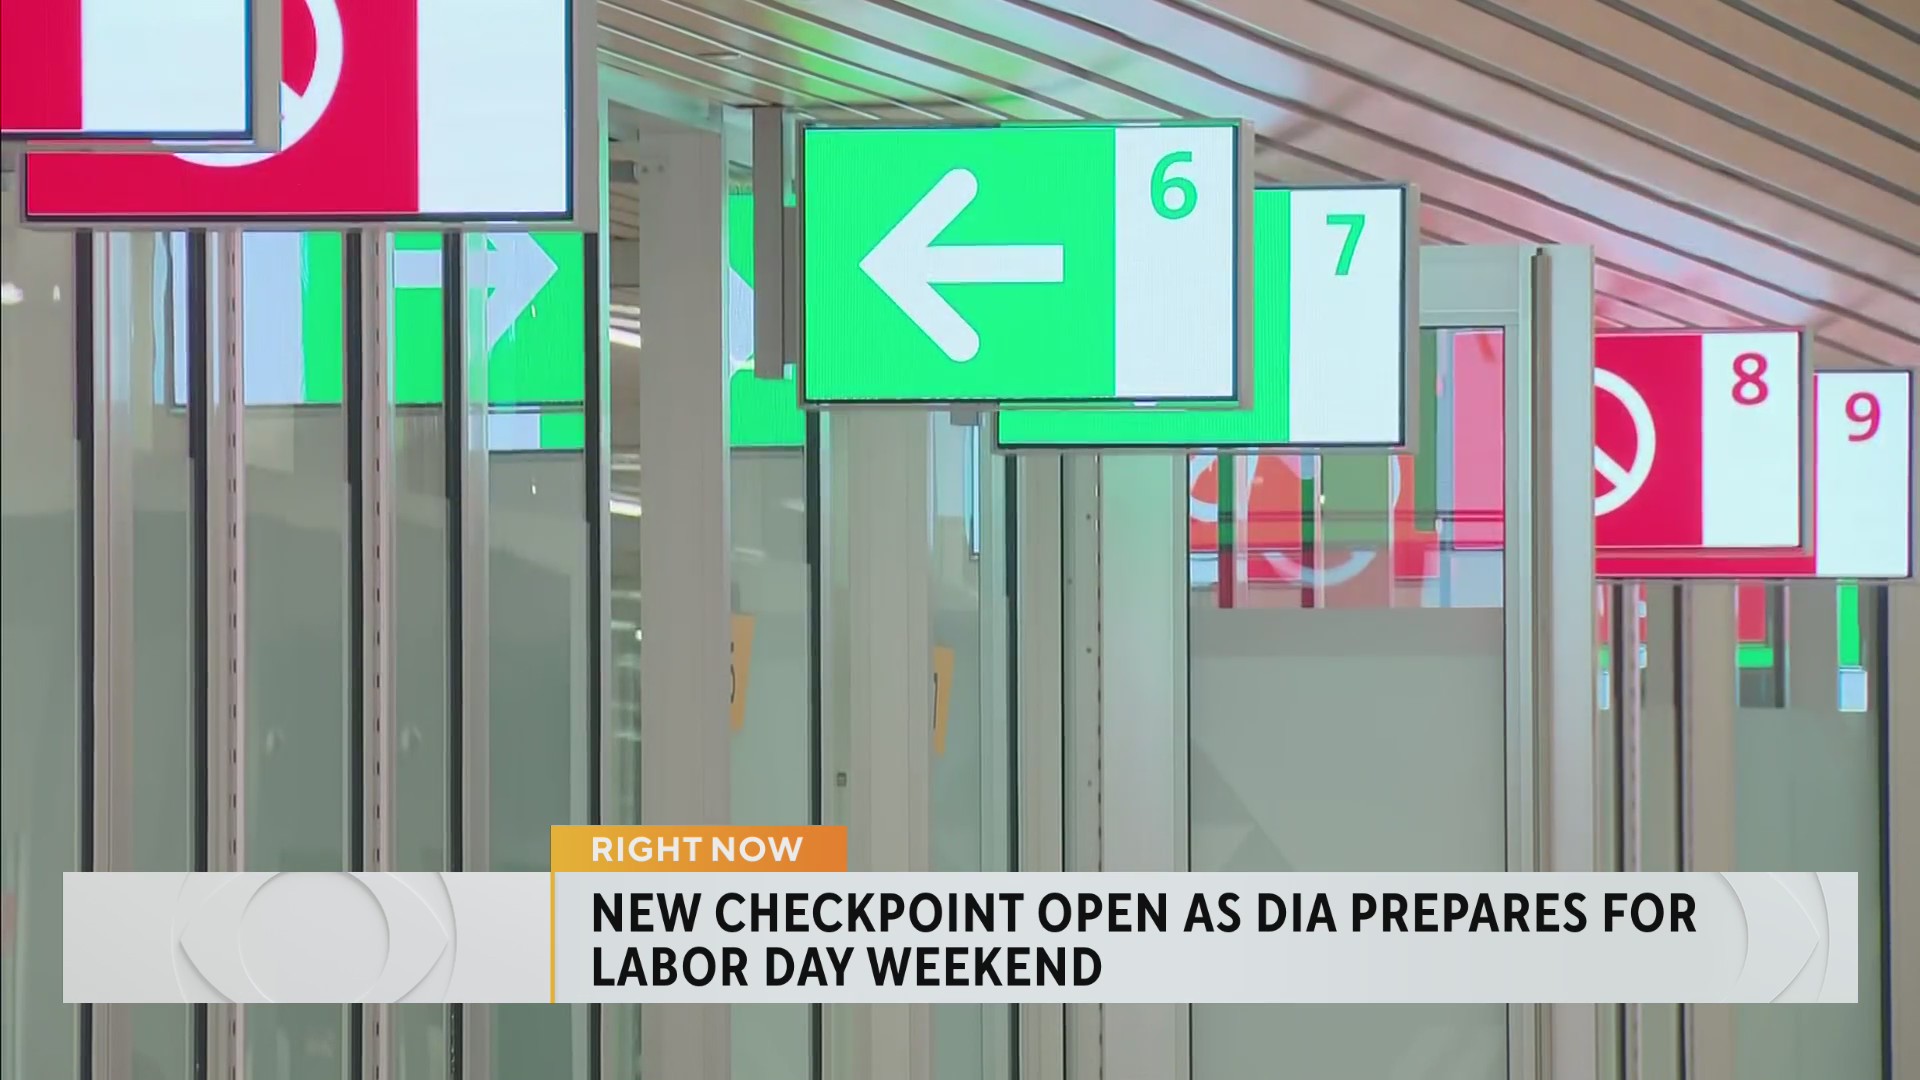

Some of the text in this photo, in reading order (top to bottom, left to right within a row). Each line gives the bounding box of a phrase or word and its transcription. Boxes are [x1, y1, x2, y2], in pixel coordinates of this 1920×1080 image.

[1149, 148, 1199, 222] 6
[1325, 211, 1368, 278] 7
[1731, 352, 1769, 405] 8
[1844, 391, 1882, 442] 9
